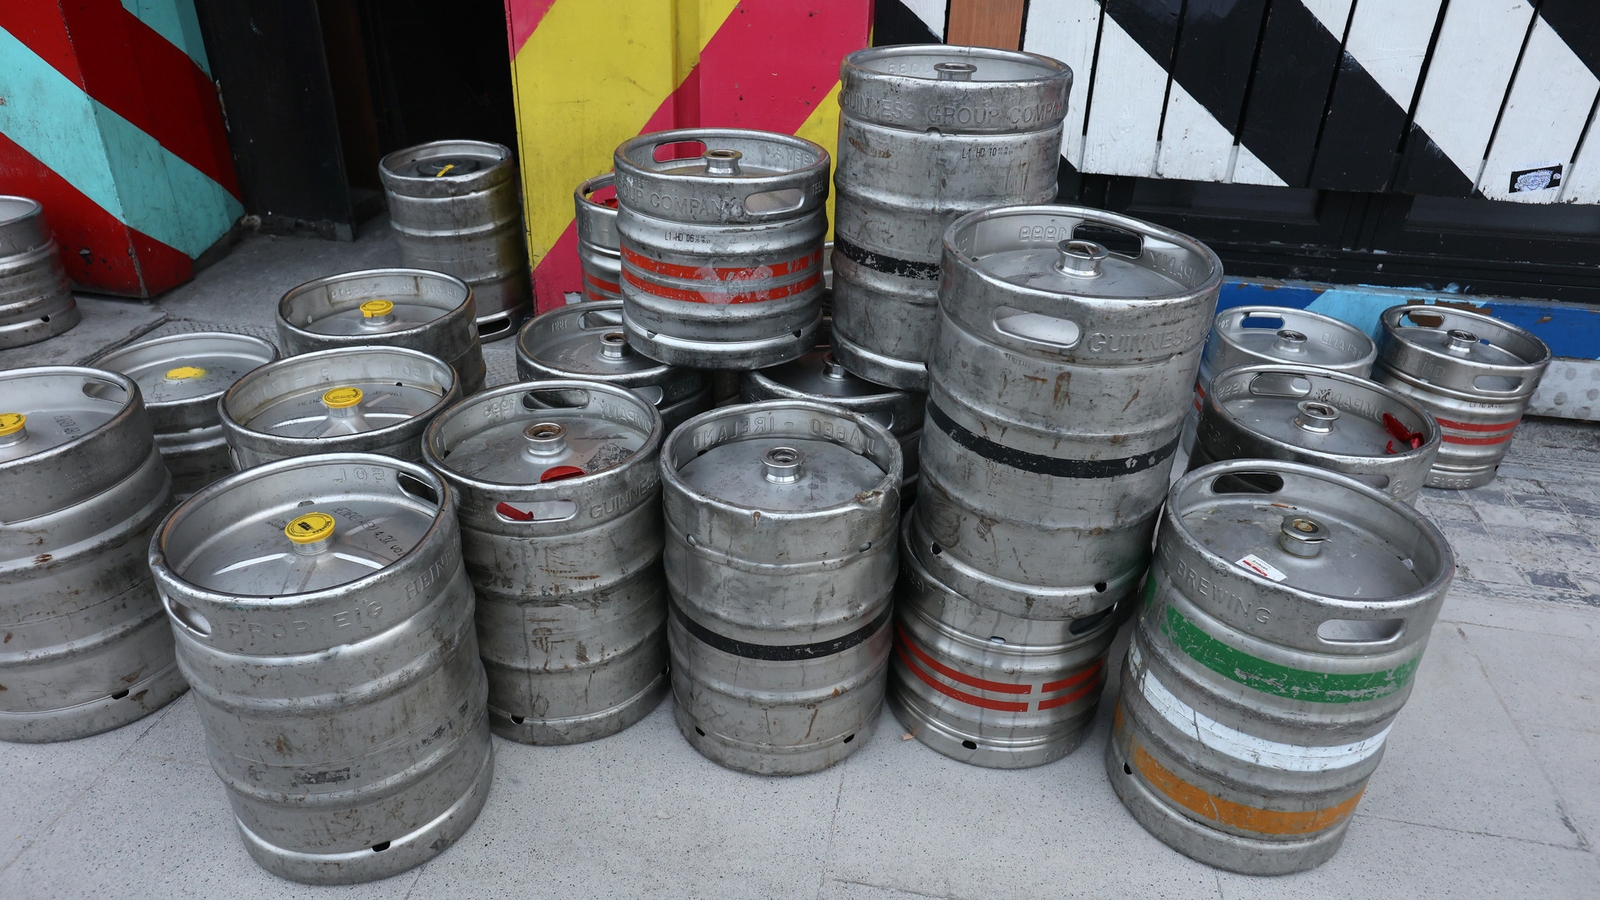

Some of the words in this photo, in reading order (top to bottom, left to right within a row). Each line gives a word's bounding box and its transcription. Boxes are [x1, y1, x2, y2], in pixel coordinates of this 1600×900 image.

[926, 106, 1000, 125] GROUP
[1086, 325, 1197, 355] GUINNESS
[1176, 558, 1273, 625] BREWING
